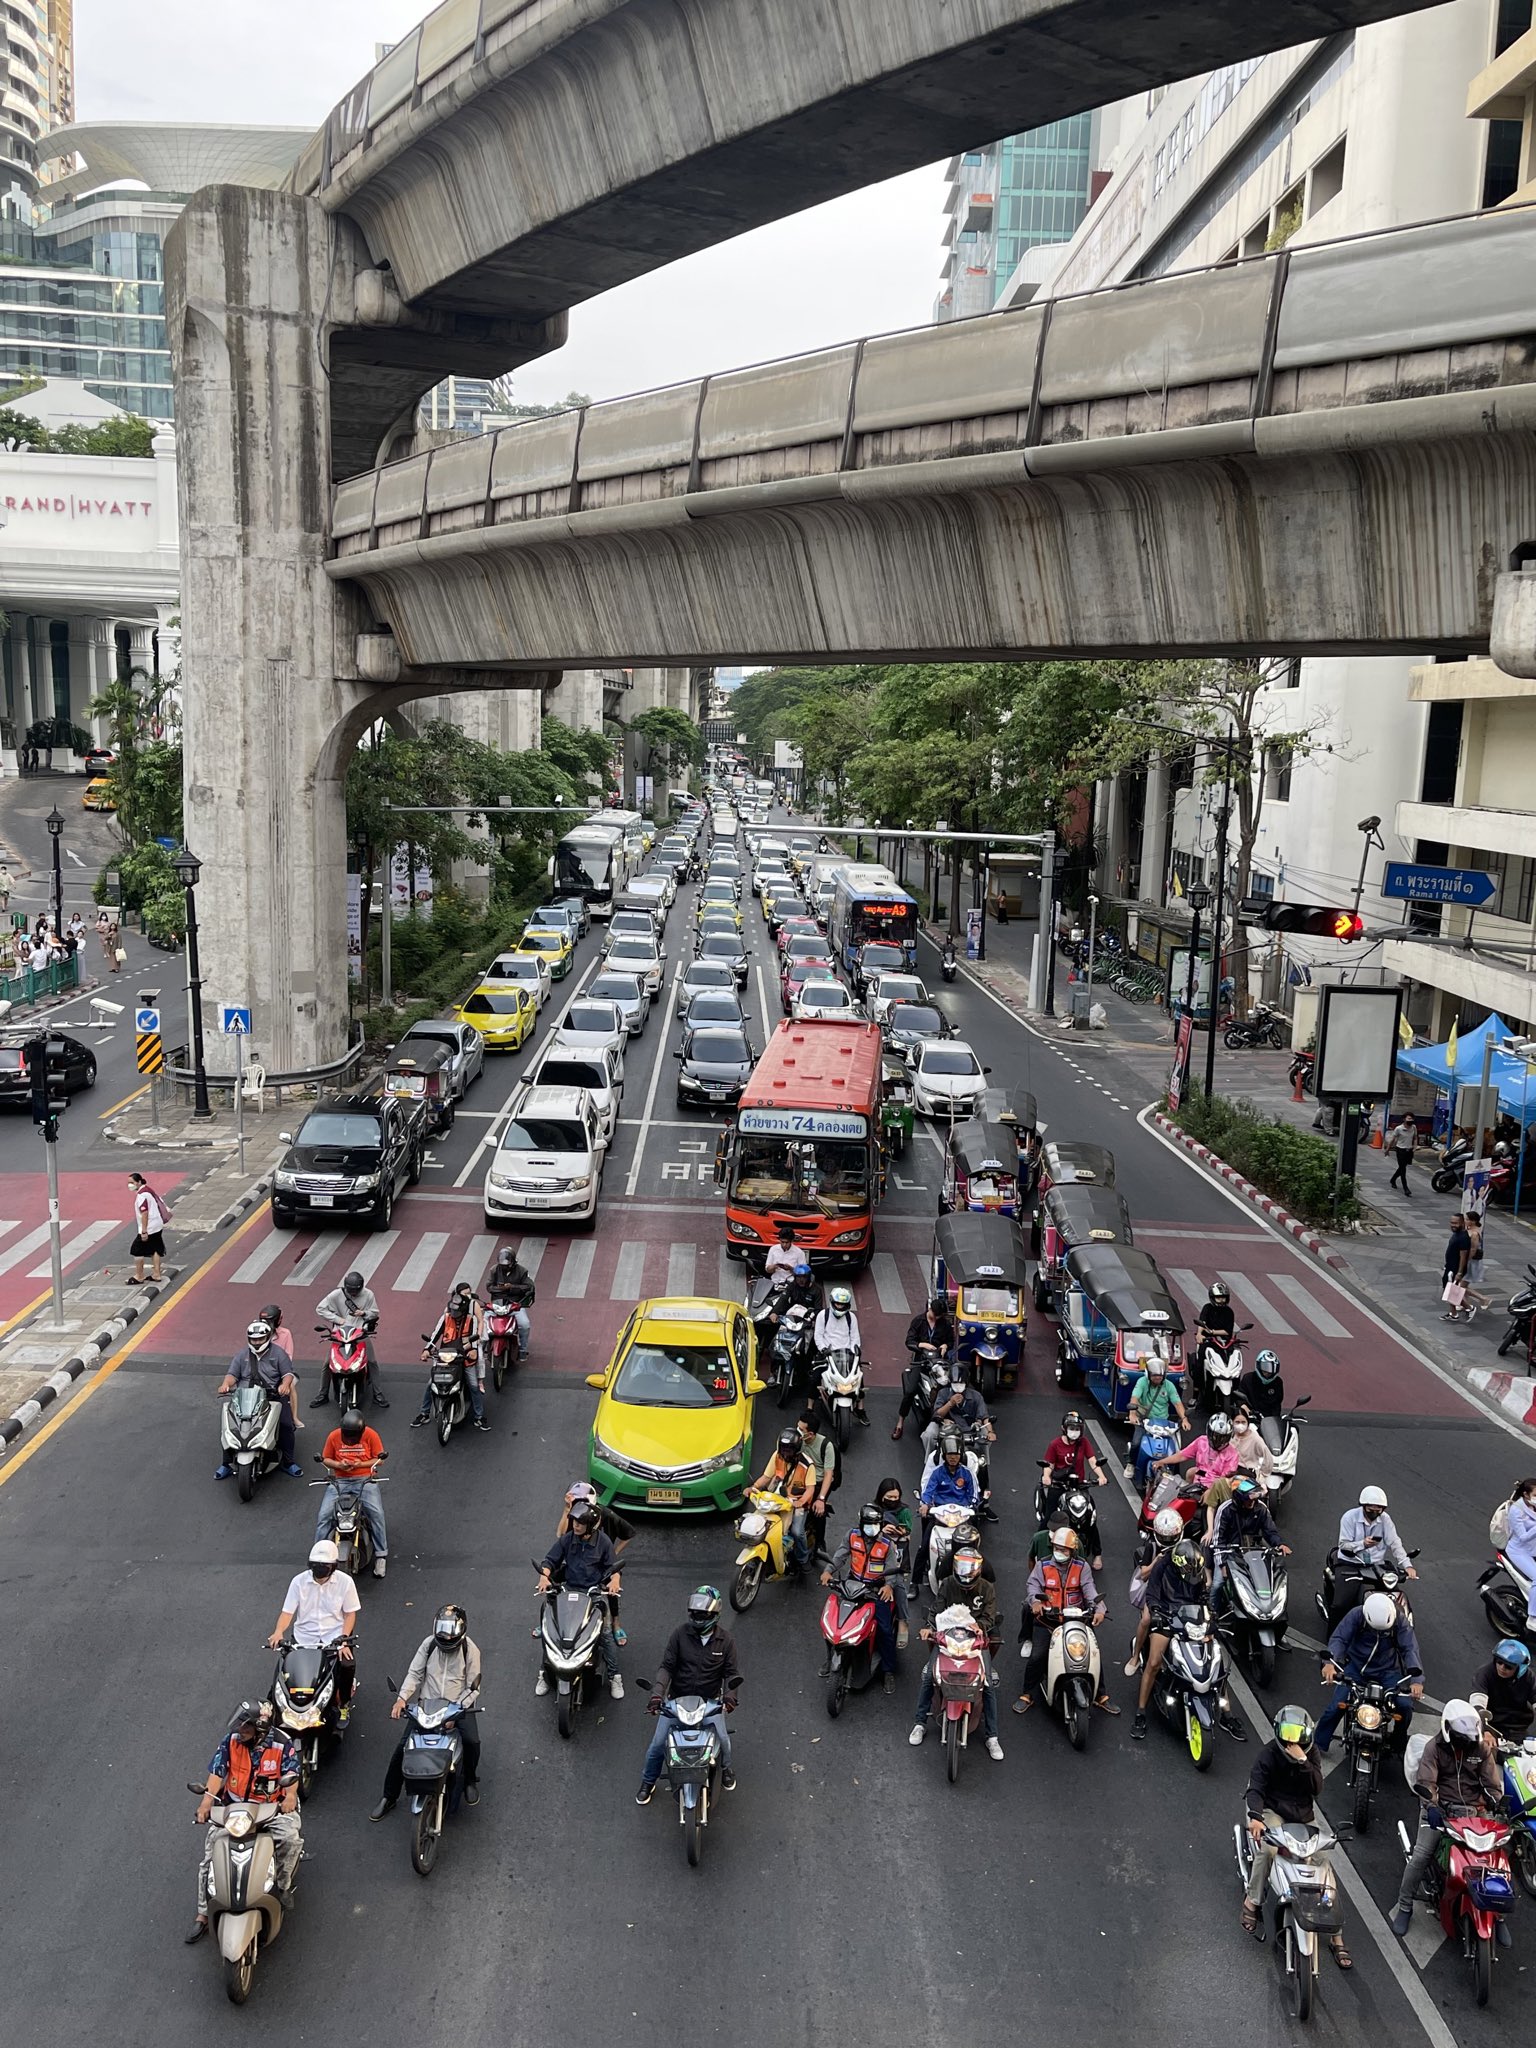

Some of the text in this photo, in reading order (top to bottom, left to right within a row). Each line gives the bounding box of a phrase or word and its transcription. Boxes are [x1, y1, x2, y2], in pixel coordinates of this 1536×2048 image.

[3, 496, 152, 517] RAND HYATT
[1409, 888, 1433, 899] Rama
[892, 904, 907, 917] A3
[743, 1113, 863, 1135] ห้วยขวาง 74 คลองเตย
[784, 1141, 800, 1151] 74
